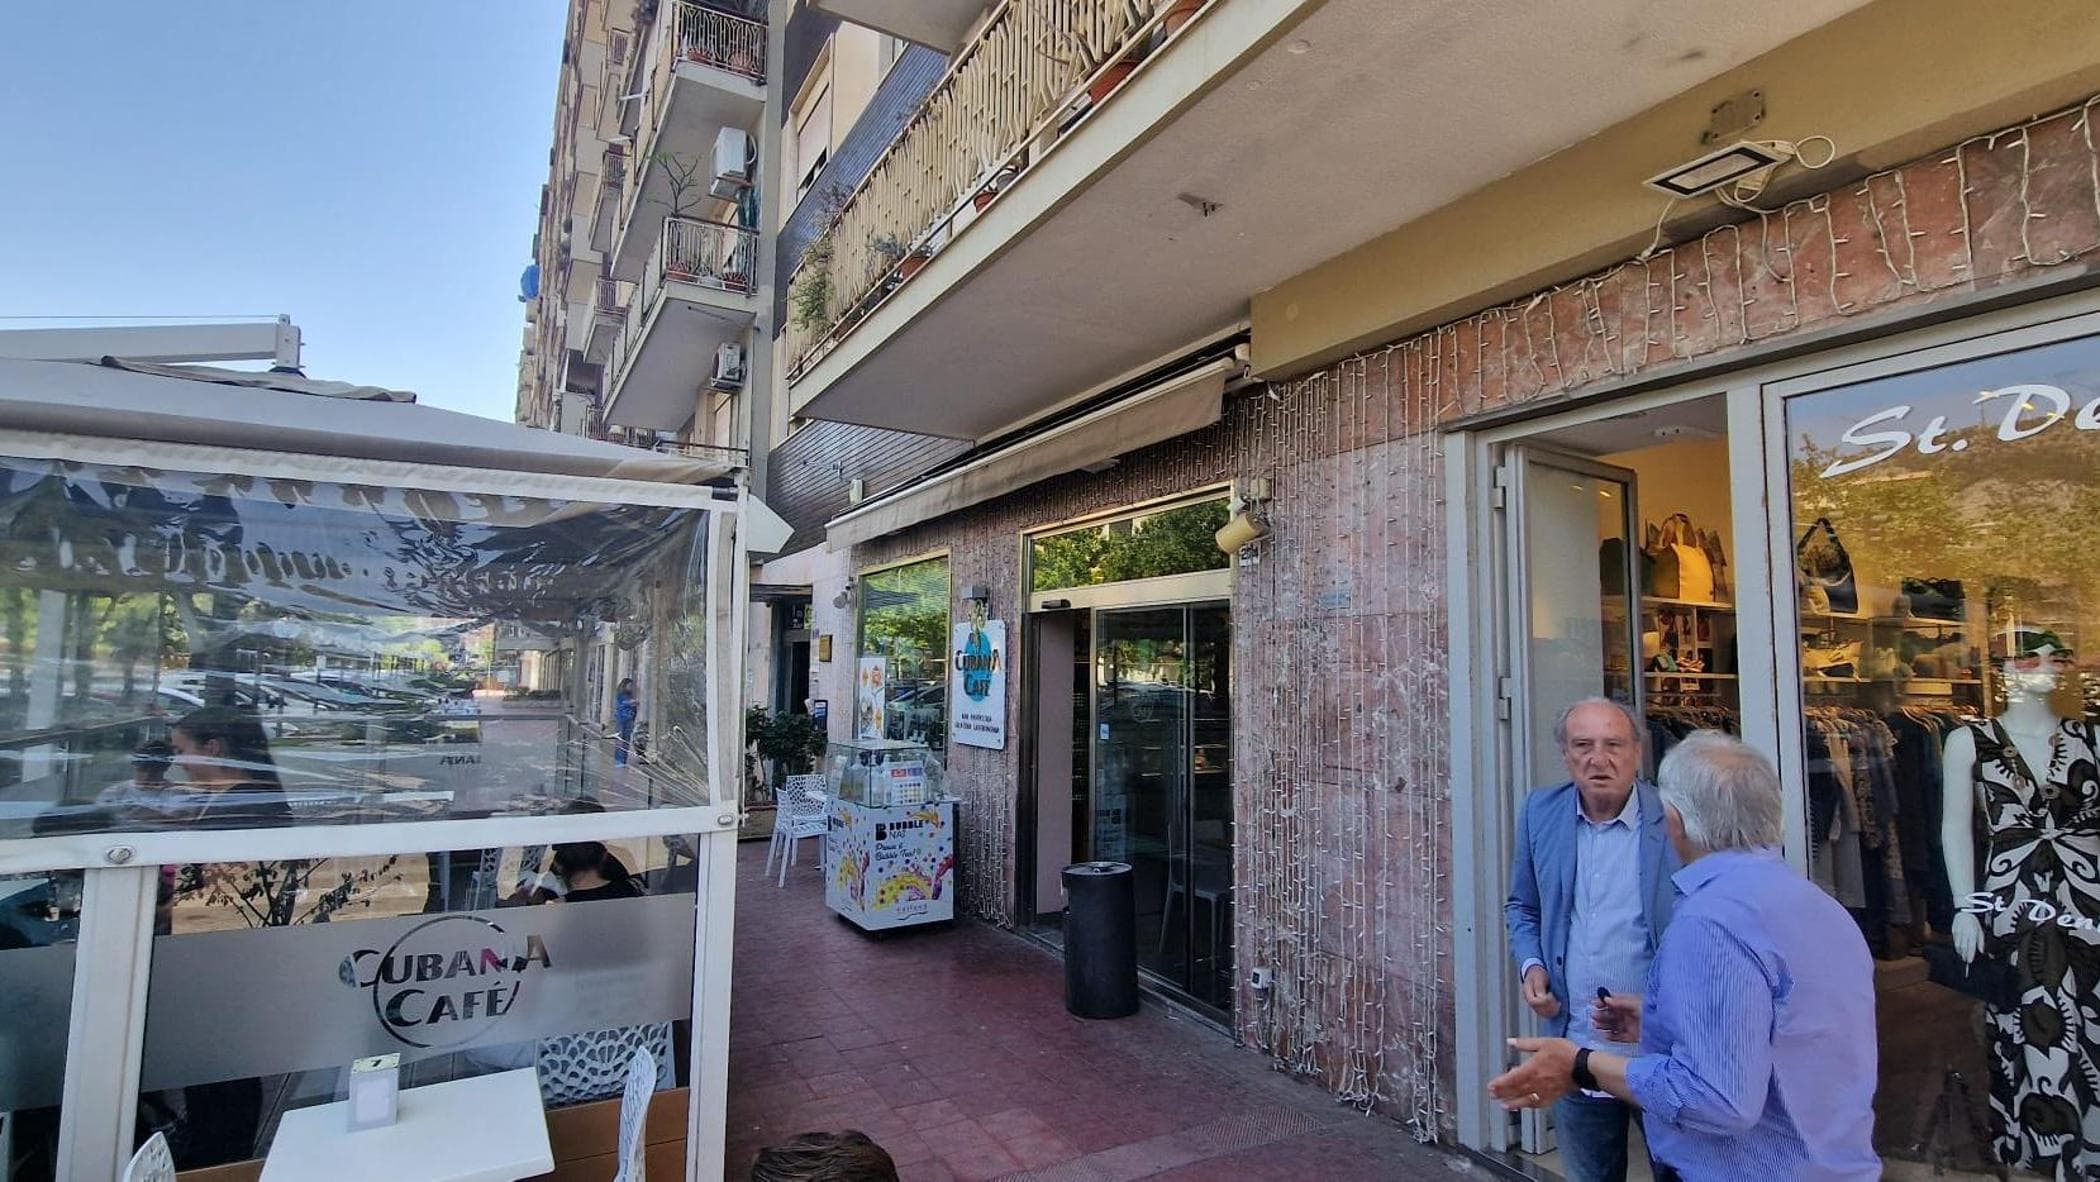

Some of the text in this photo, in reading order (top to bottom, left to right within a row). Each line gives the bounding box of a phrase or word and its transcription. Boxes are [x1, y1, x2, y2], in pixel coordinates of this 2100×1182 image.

[1819, 405, 1968, 478] St.
[955, 649, 1002, 671] CUBANA
[889, 819, 925, 831] BUBBLE
[1960, 891, 2100, 933] St Den
[338, 934, 553, 988] CUBANA
[385, 980, 509, 1028] CAFÉ
